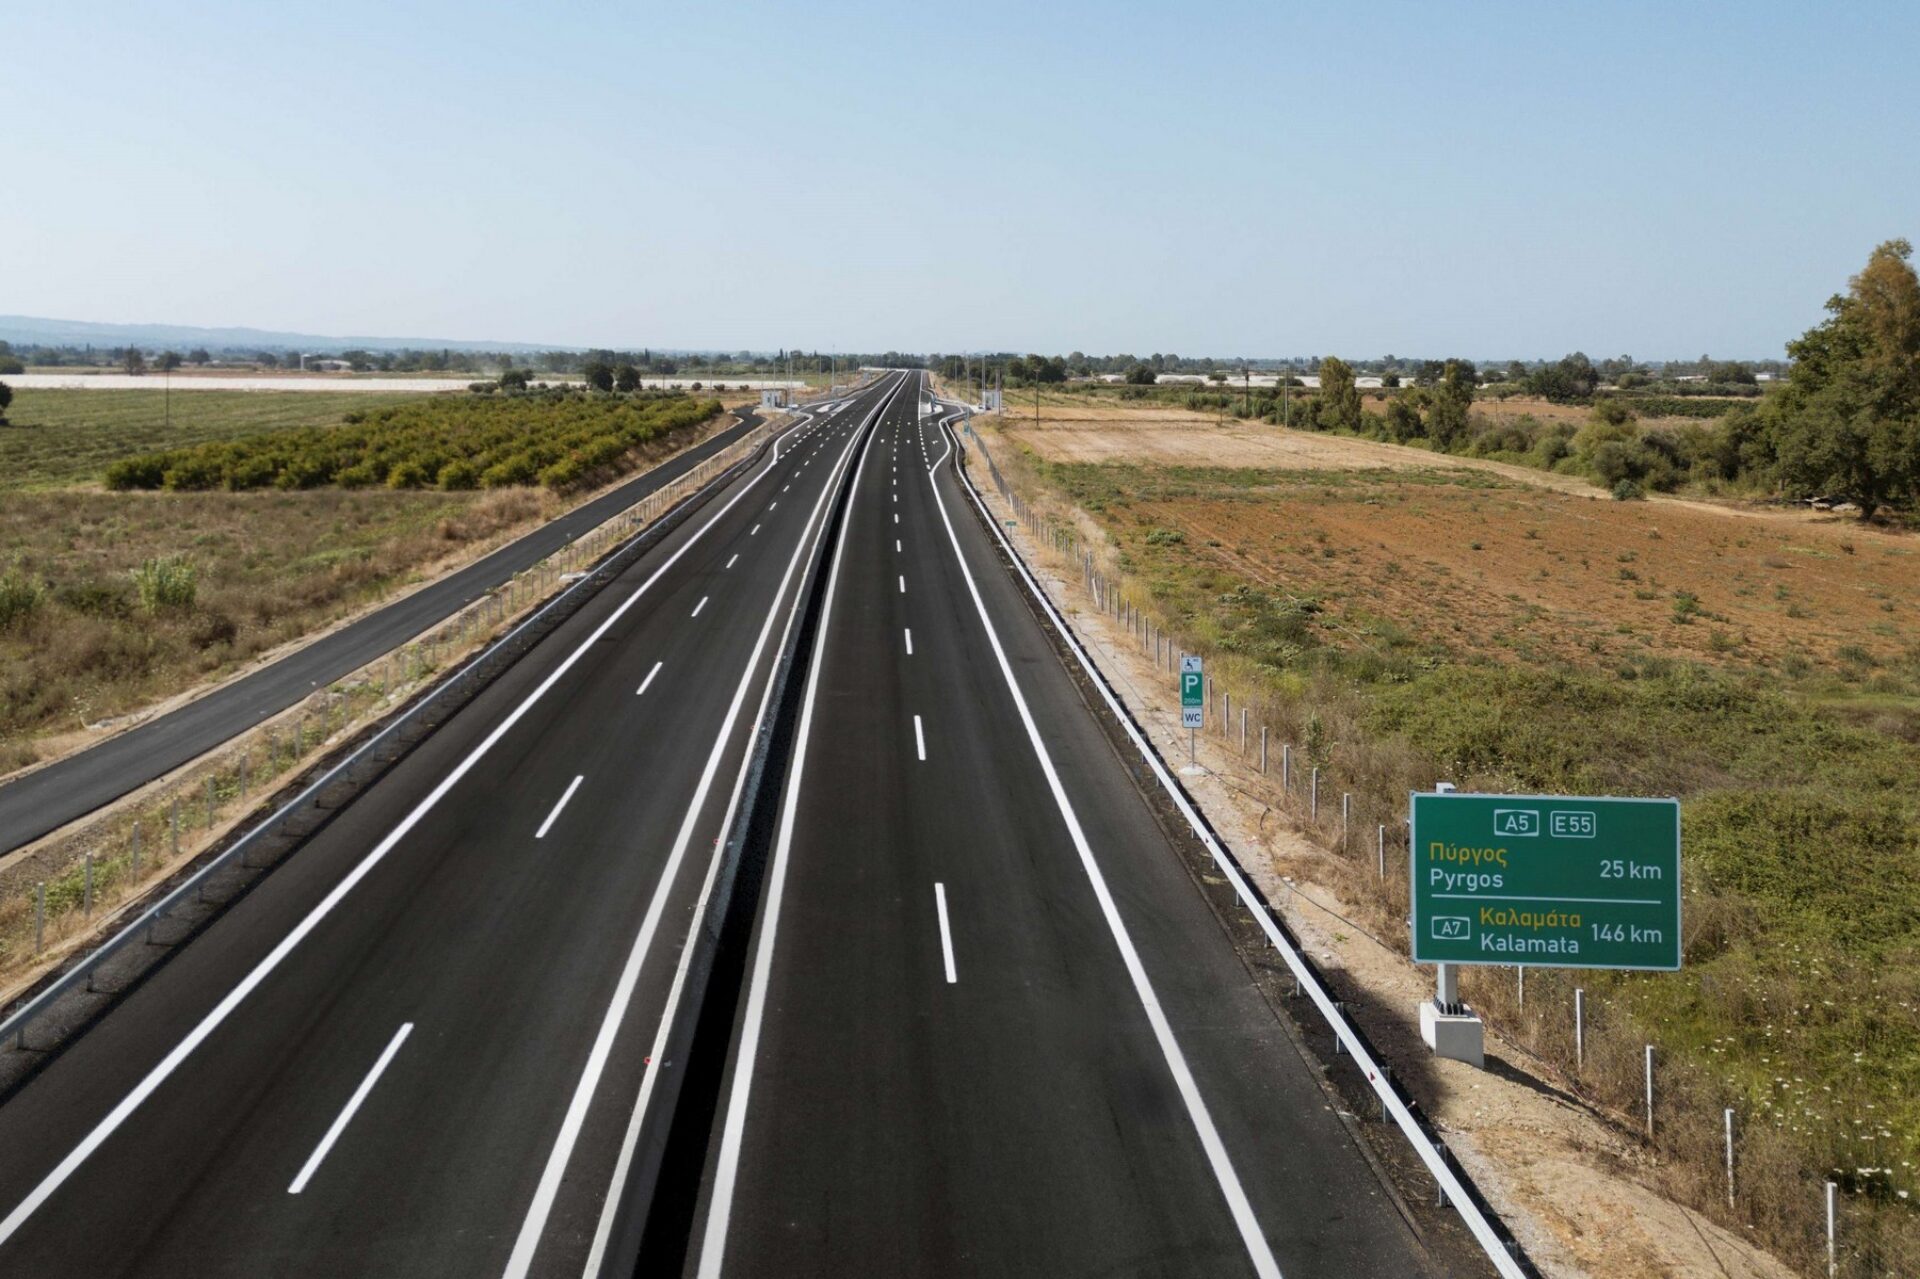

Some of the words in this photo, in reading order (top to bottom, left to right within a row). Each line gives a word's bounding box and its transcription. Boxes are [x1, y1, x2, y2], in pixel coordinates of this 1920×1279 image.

[1185, 675, 1199, 694] P
[1185, 713, 1201, 722] WC
[1505, 815, 1529, 831] A5
[1430, 842, 1508, 868] Πύργος
[1600, 860, 1624, 878] 25
[1629, 861, 1662, 879] km
[1430, 868, 1504, 892] Pyrgos
[1441, 921, 1461, 936] A7
[1480, 907, 1581, 931] Καλαμάτα
[1591, 923, 1625, 942] 146
[1630, 924, 1662, 943] km
[1480, 933, 1579, 954] Kalamata
